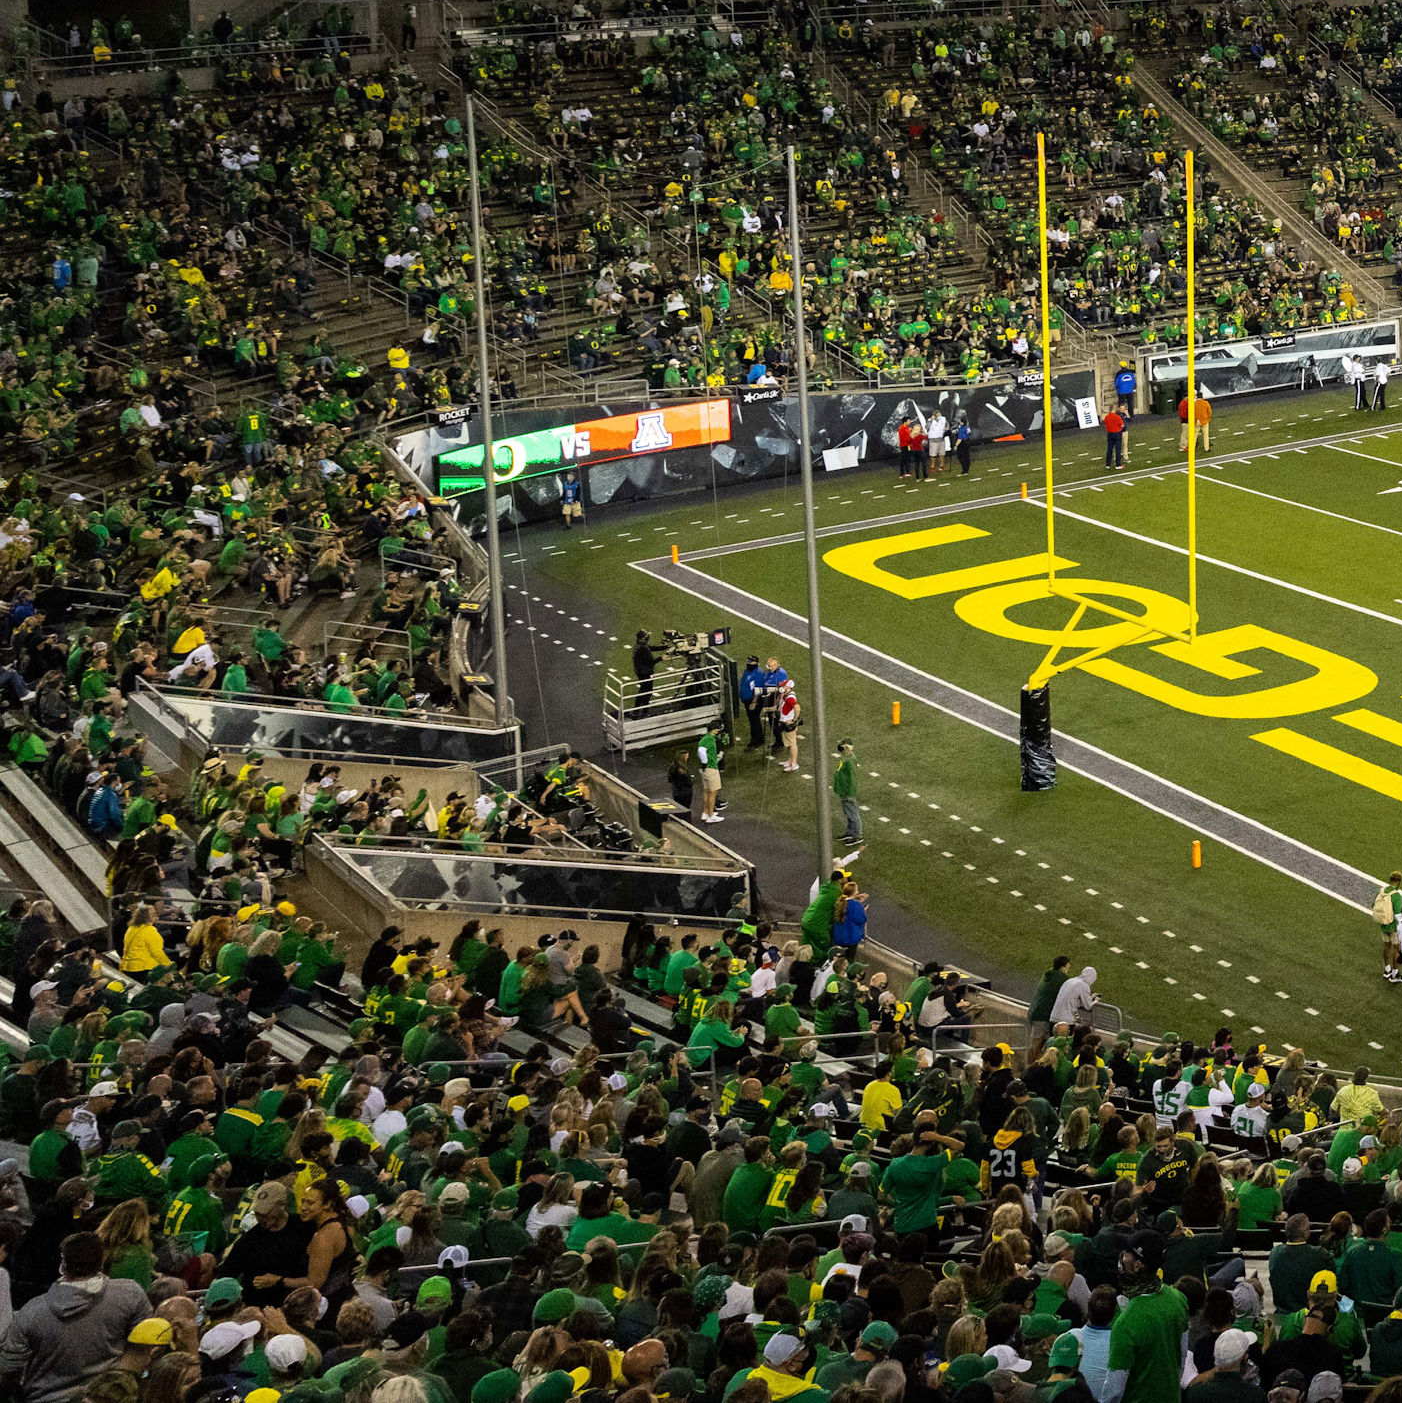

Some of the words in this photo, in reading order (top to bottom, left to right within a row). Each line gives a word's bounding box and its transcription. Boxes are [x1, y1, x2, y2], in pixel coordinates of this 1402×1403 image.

[1017, 372, 1045, 384] ROCKE
[438, 407, 471, 422] ROCKET
[1081, 400, 1093, 425] DUCS
[631, 411, 673, 455] A
[562, 430, 591, 470] VS
[989, 1150, 1017, 1178] 23
[1154, 1159, 1188, 1178] OREGON
[1167, 1169, 1177, 1179] O
